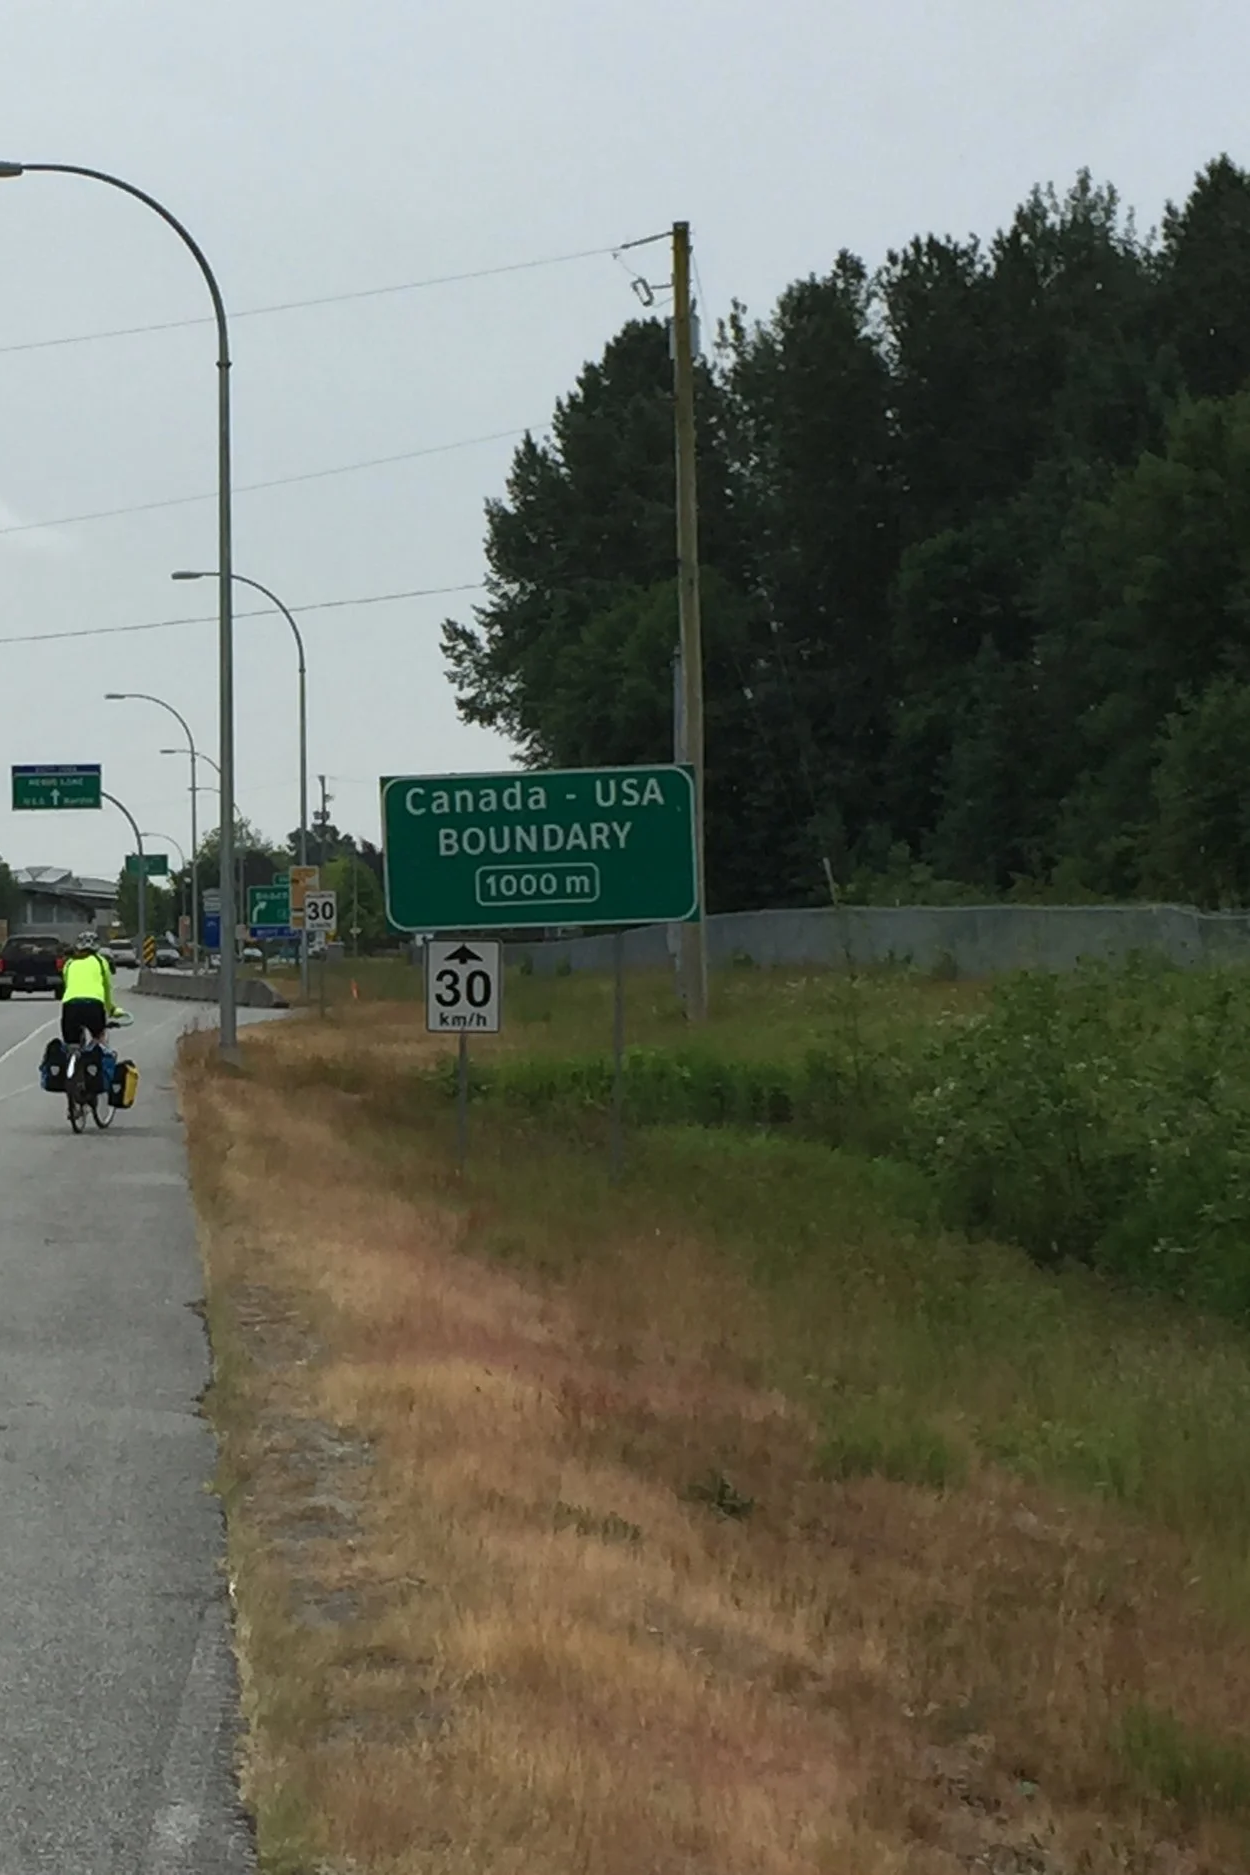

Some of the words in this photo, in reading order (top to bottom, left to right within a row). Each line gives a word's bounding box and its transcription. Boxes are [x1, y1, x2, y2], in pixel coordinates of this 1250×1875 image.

[405, 781, 547, 816] Canada
[594, 777, 665, 807] USA
[438, 821, 633, 857] BOUNDARY
[485, 873, 558, 897] 1000
[566, 875, 591, 894] m
[307, 901, 334, 920] 30
[435, 969, 491, 1008] 30
[439, 1011, 487, 1028] km/h
